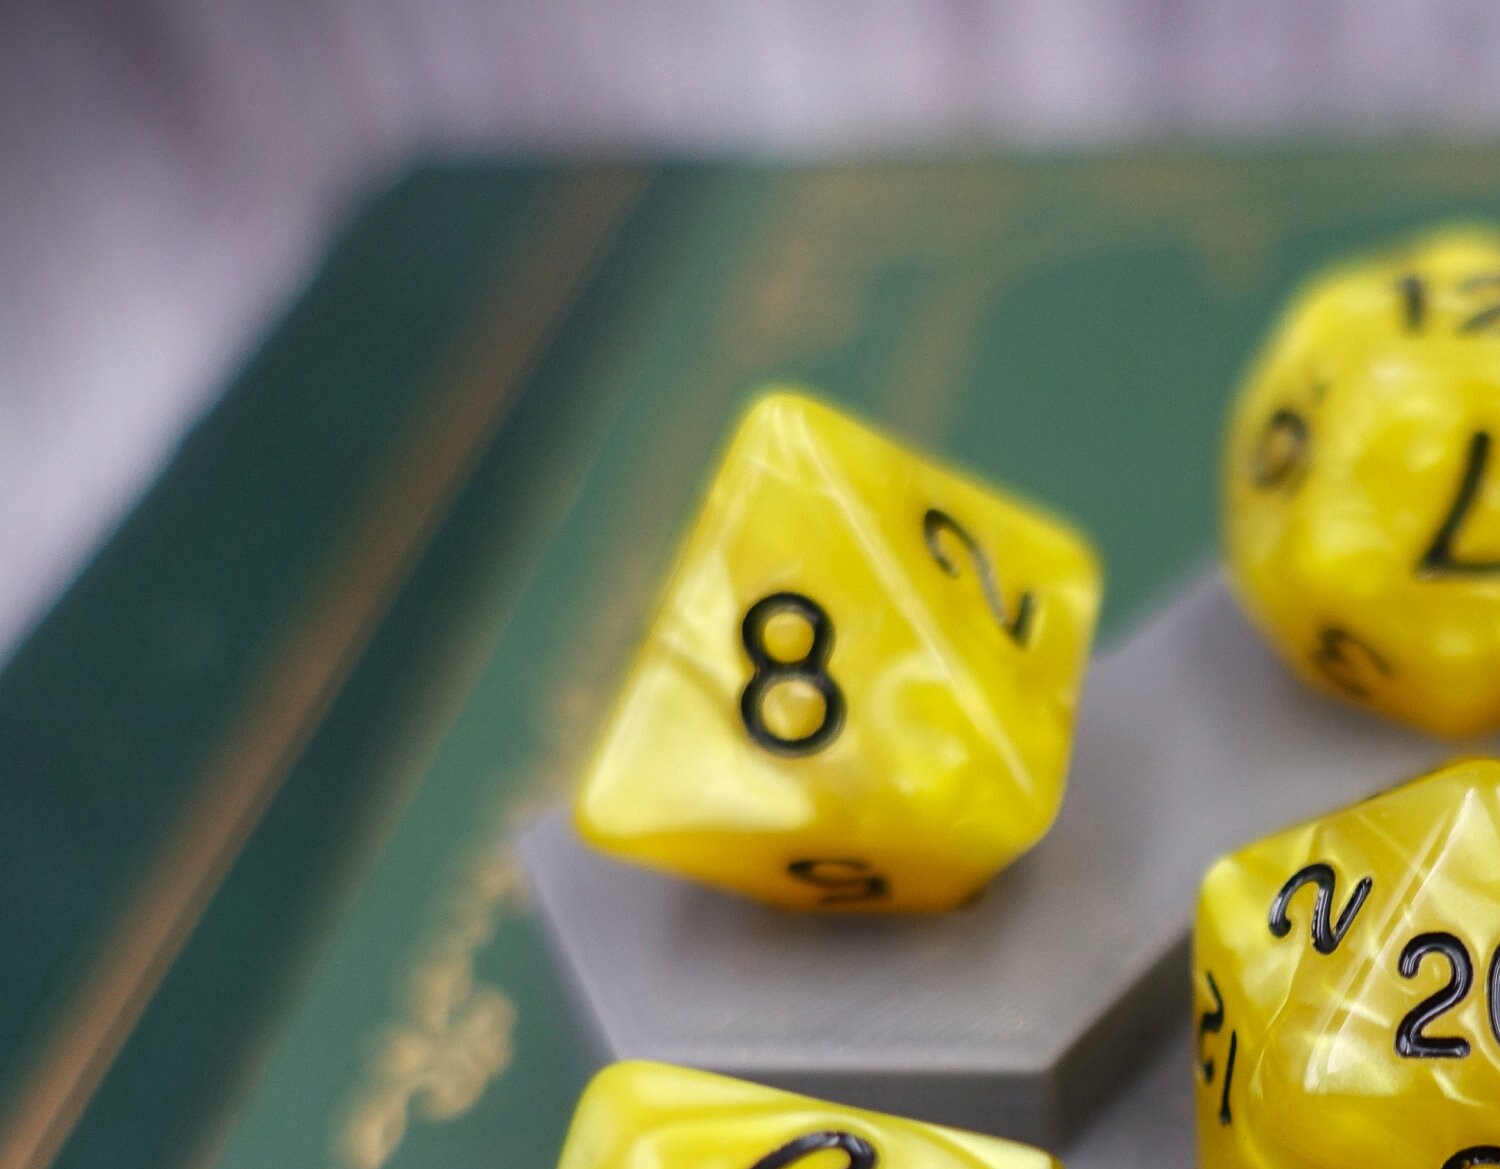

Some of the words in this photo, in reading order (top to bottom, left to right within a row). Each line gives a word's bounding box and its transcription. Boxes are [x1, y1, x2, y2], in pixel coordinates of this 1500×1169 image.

[922, 507, 1035, 646] 2
[739, 592, 845, 756] 8
[1269, 863, 1372, 955] 2
